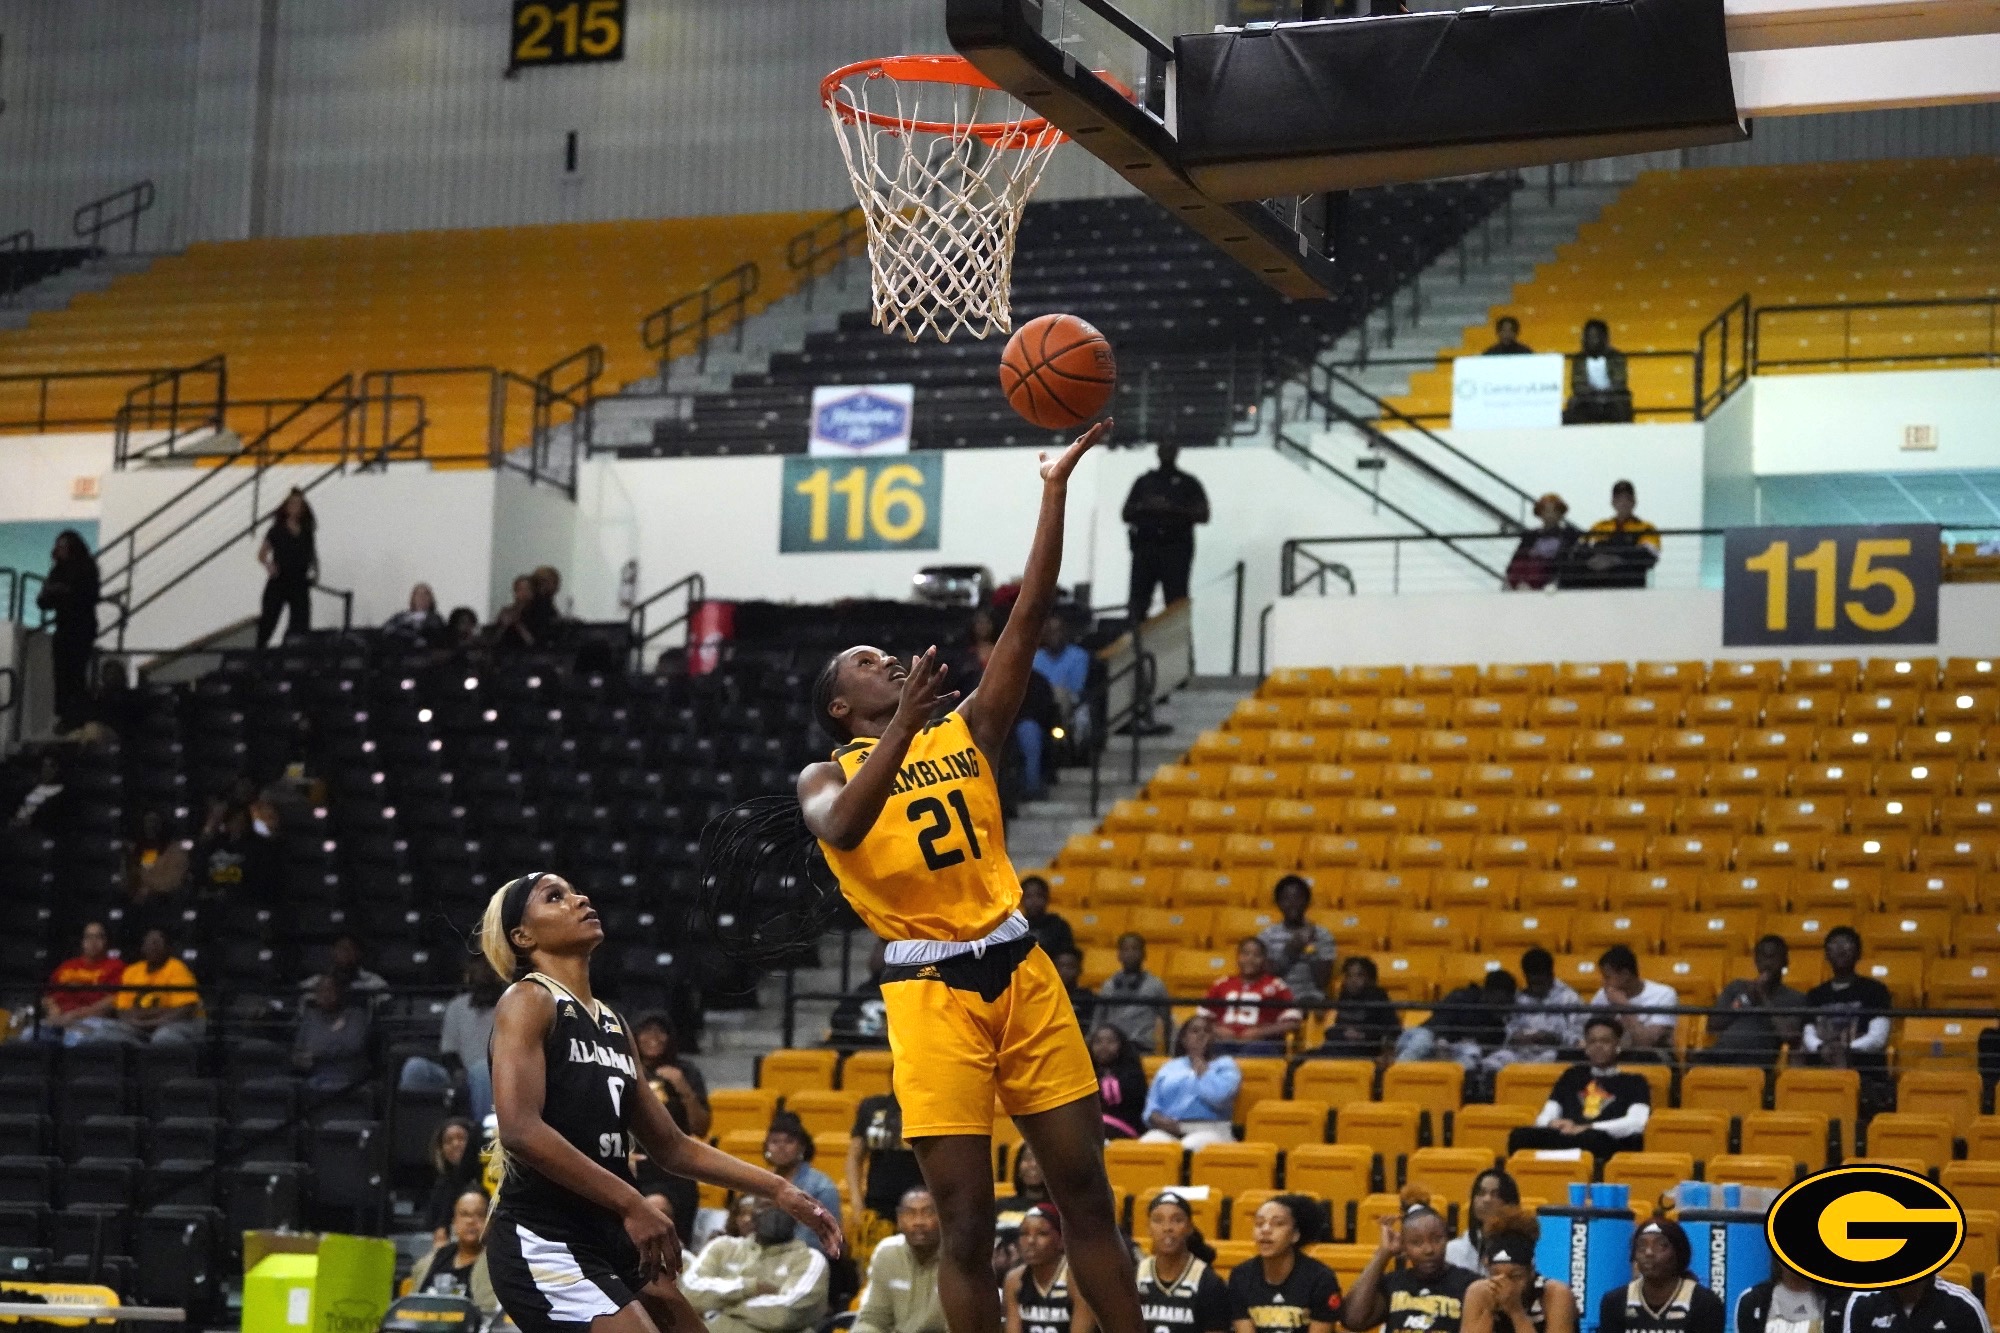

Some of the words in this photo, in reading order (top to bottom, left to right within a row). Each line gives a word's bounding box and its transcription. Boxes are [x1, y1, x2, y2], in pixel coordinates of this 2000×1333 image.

[517, 1, 621, 58] 215
[796, 464, 926, 543] 116
[1745, 538, 1916, 631] 115
[889, 747, 980, 797] AMBLING
[906, 789, 982, 871] 21
